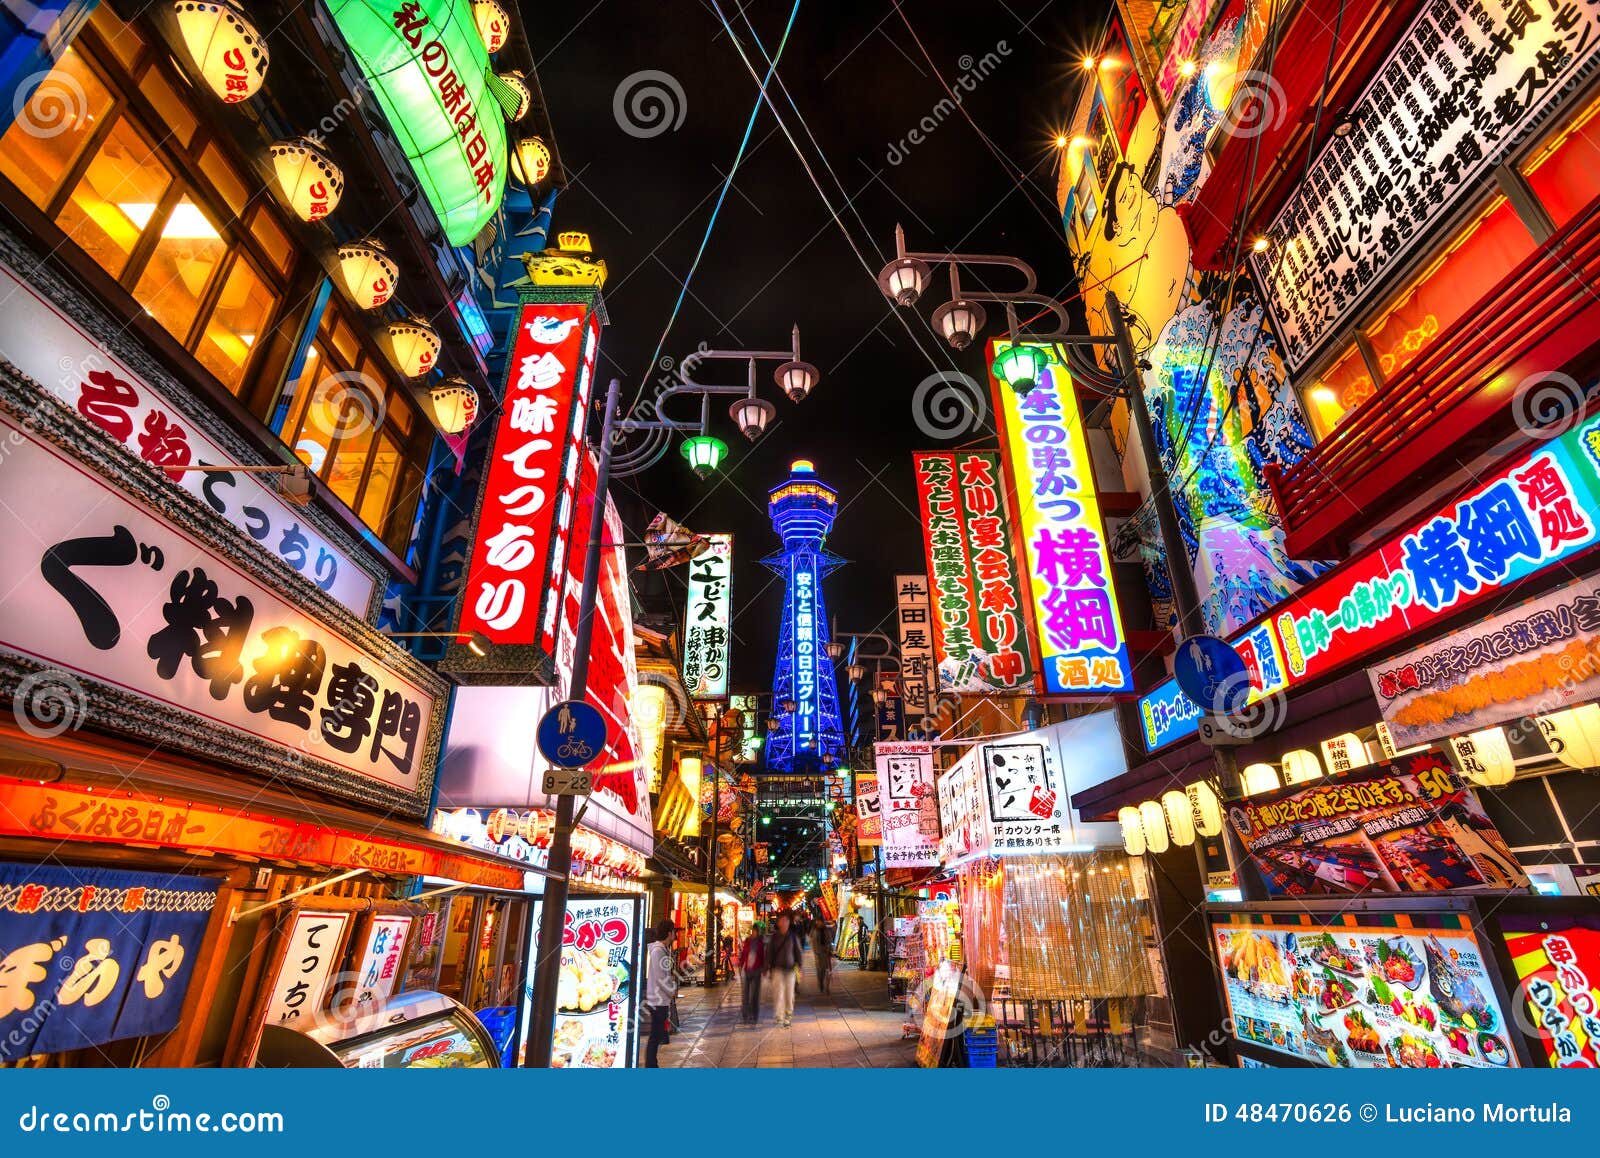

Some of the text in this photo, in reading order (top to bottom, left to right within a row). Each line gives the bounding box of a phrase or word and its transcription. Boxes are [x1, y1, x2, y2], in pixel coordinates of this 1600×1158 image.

[393, 1, 494, 204] 私の味は日本一
[78, 370, 338, 592] 名物てっちり
[474, 352, 566, 630] 珍味てっちり
[1515, 456, 1590, 549] 酒処
[961, 455, 1025, 686] 大小宴会承り中
[1405, 480, 1545, 609] 横綱
[1034, 527, 1120, 653] 横綱
[1296, 572, 1410, 657] 日本一の串かつ
[41, 525, 421, 775] ぐ料理専門
[684, 626, 702, 692] お好み焼き
[703, 626, 728, 680] 串かつ
[796, 572, 815, 749] 安心と信頼の日立グループ
[899, 582, 932, 708] 半田屋酒店
[1060, 656, 1121, 687] 酒処
[1252, 628, 1282, 690] 酒処
[31, 797, 206, 843] ふぐなら日本一
[350, 845, 416, 872] ふぐなら日本一
[1005, 824, 1061, 835] カウンター席
[1006, 837, 1061, 848] 座敷あります
[381, 928, 403, 980] 土産
[576, 906, 619, 919] 新世界名物
